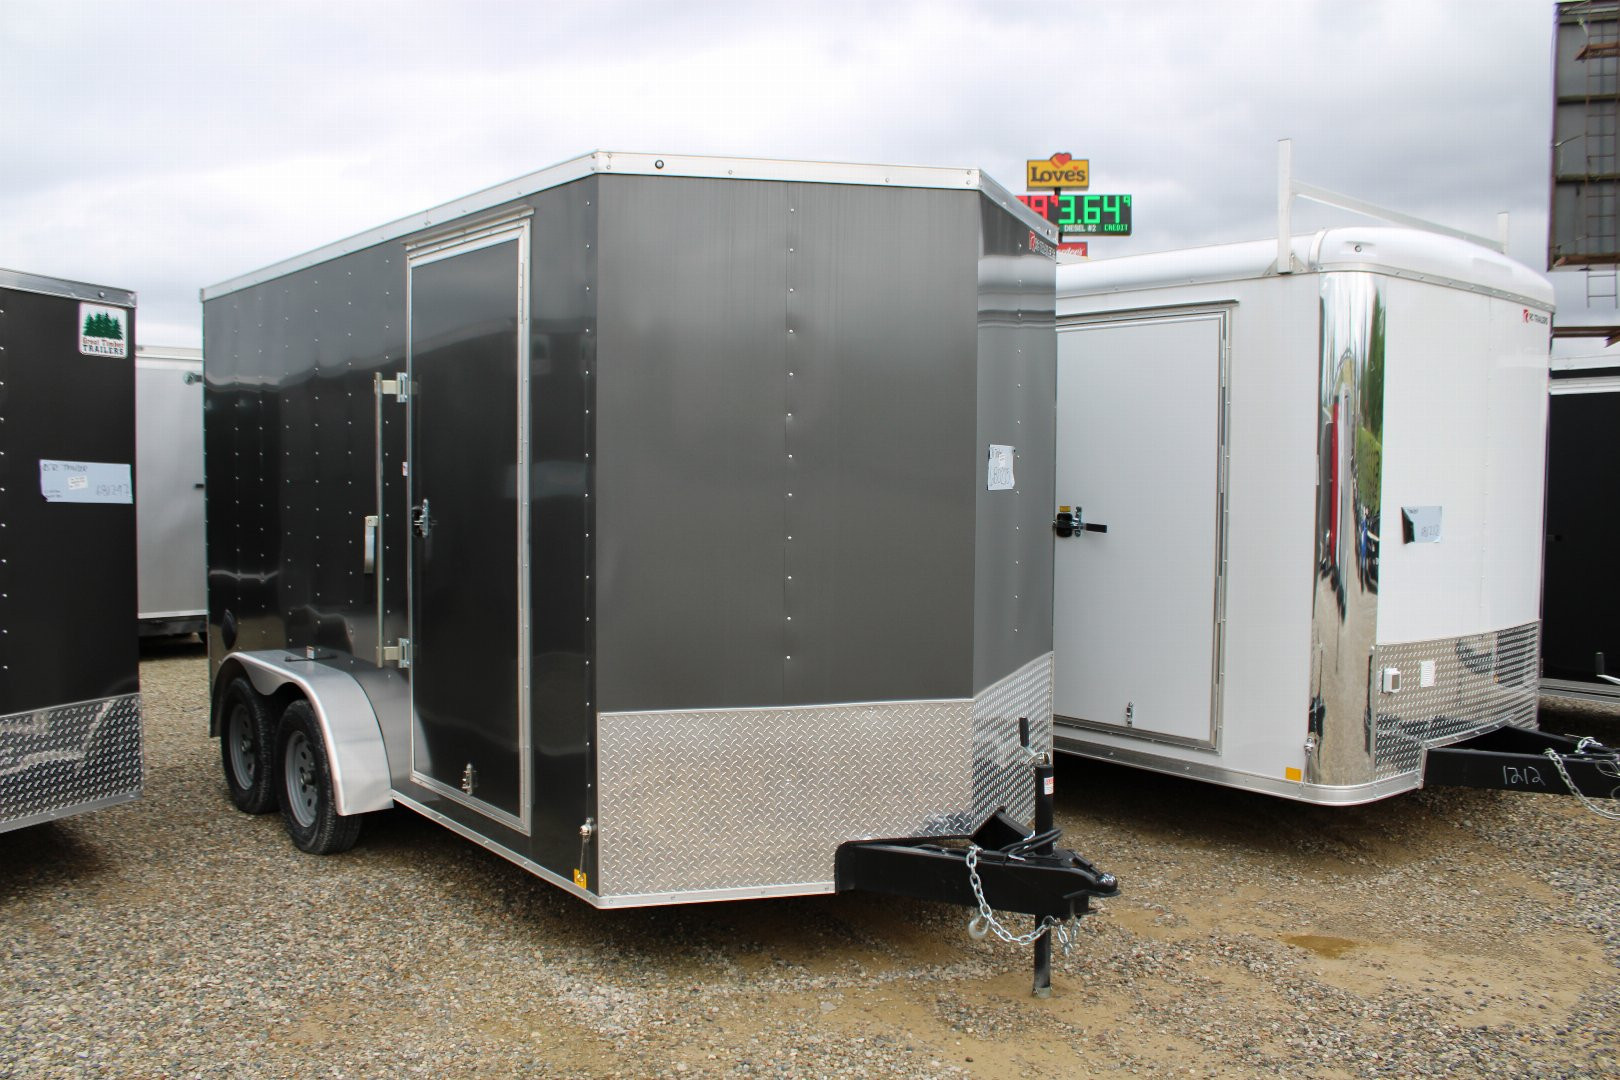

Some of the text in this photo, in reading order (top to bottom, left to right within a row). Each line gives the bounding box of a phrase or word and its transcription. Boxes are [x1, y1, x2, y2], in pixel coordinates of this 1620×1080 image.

[1030, 166, 1086, 182] Love's
[1064, 224, 1085, 232] DIESEL
[1104, 224, 1128, 232] CREDIT
[101, 339, 124, 348] Timber
[83, 345, 124, 355] TRAILERS
[1503, 765, 1546, 786] 1212
